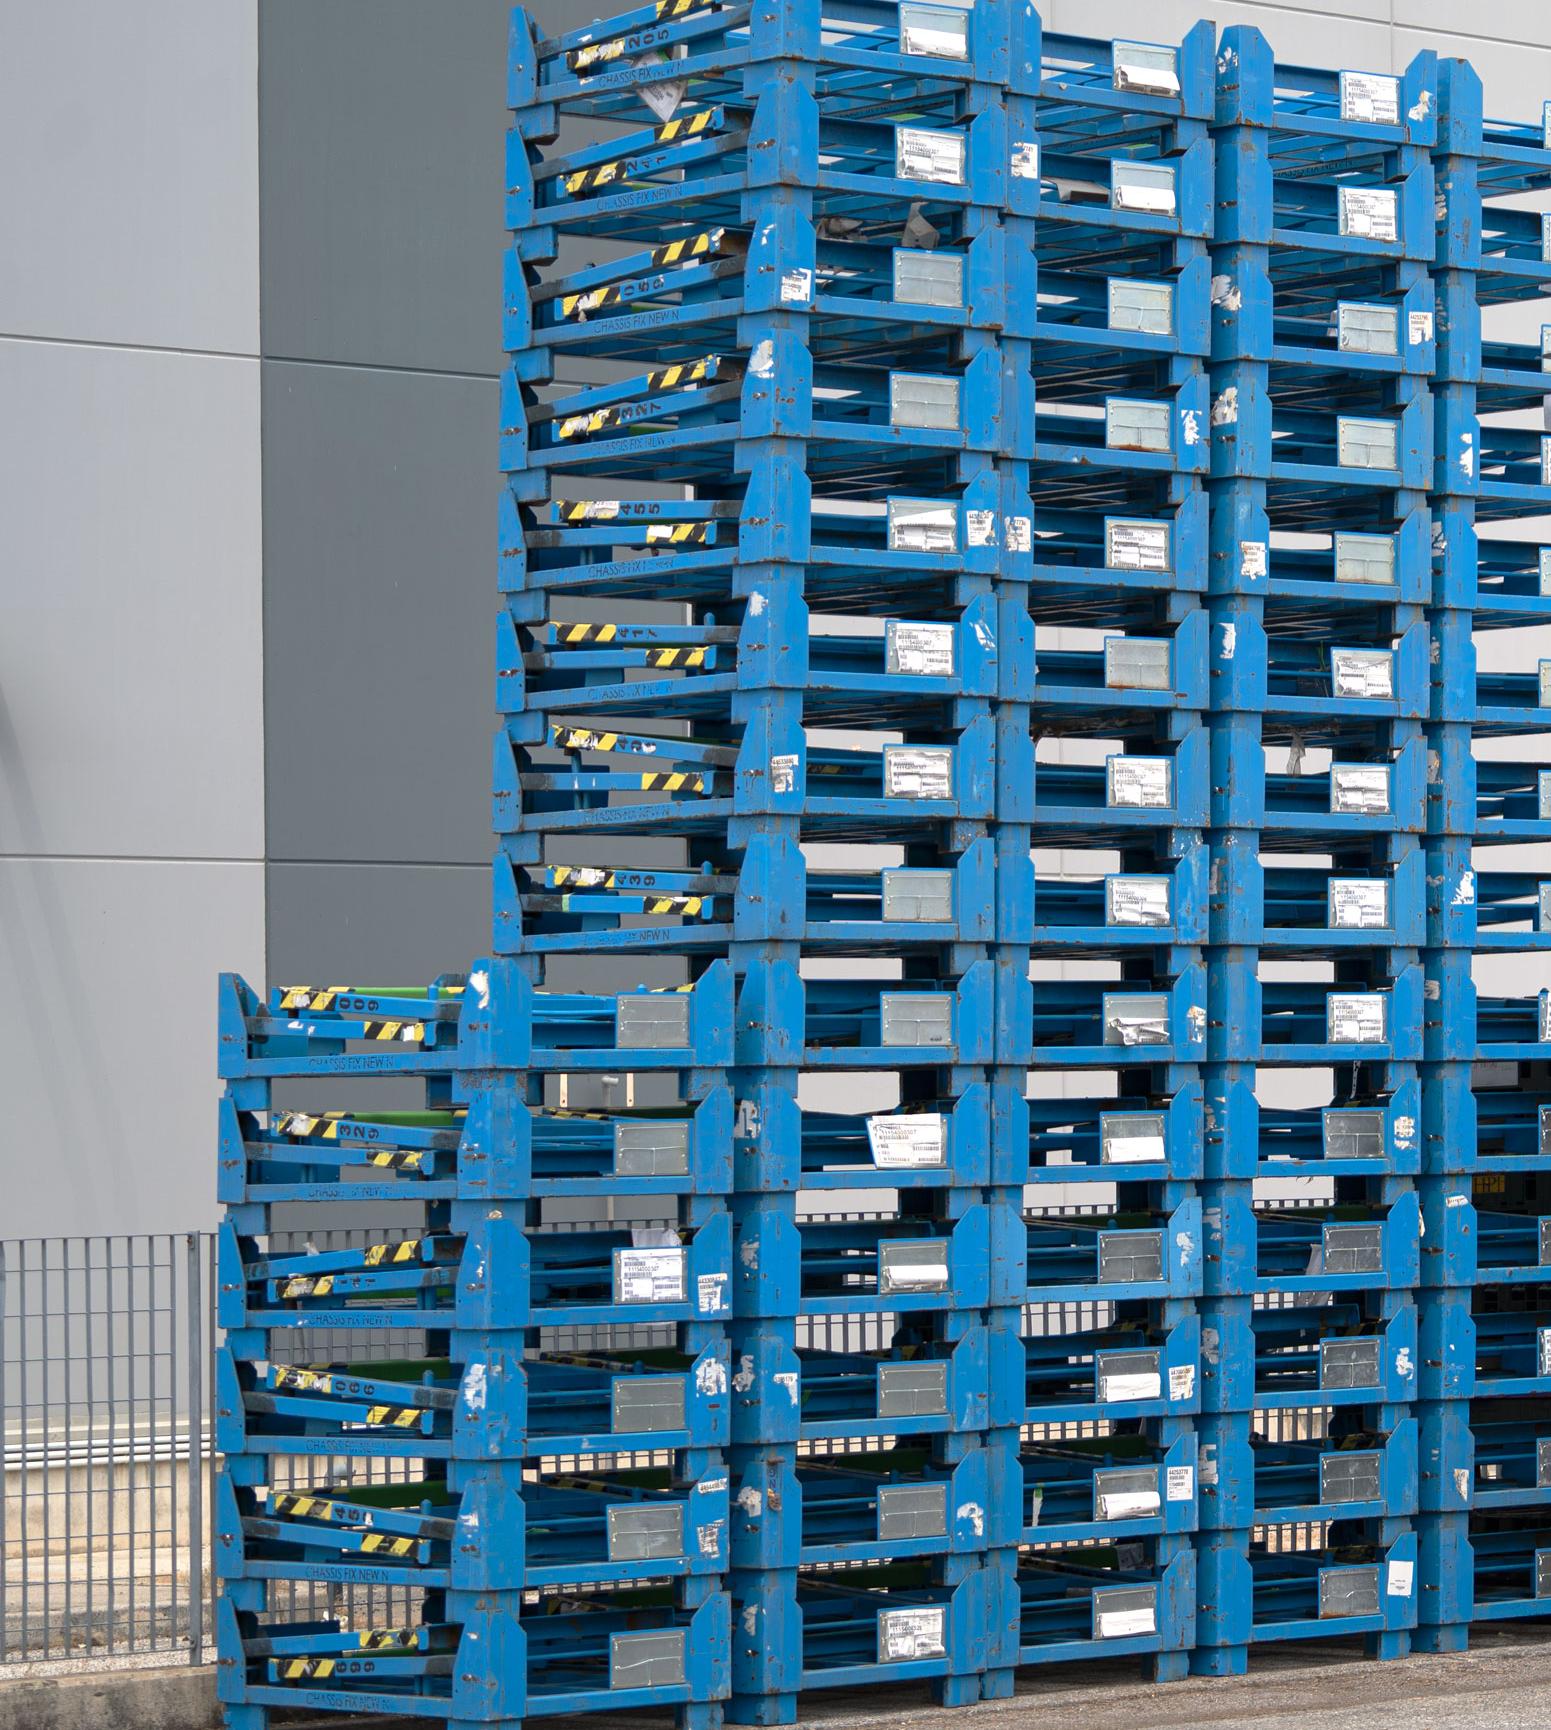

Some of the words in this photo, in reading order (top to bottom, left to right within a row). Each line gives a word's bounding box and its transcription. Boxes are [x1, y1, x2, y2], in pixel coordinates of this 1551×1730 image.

[628, 29, 669, 49] 205
[639, 66, 651, 80] FIX
[633, 315, 647, 329] FIX
[650, 310, 670, 325] NEW
[672, 310, 680, 321] N
[621, 402, 661, 418] 327
[620, 503, 660, 515] 455
[618, 874, 656, 886] 439
[339, 997, 379, 1012] 009
[339, 1124, 380, 1139] 329
[335, 1380, 375, 1395] 066
[344, 1568, 357, 1580] FIX
[359, 1569, 379, 1581] NEW
[381, 1570, 389, 1581] N
